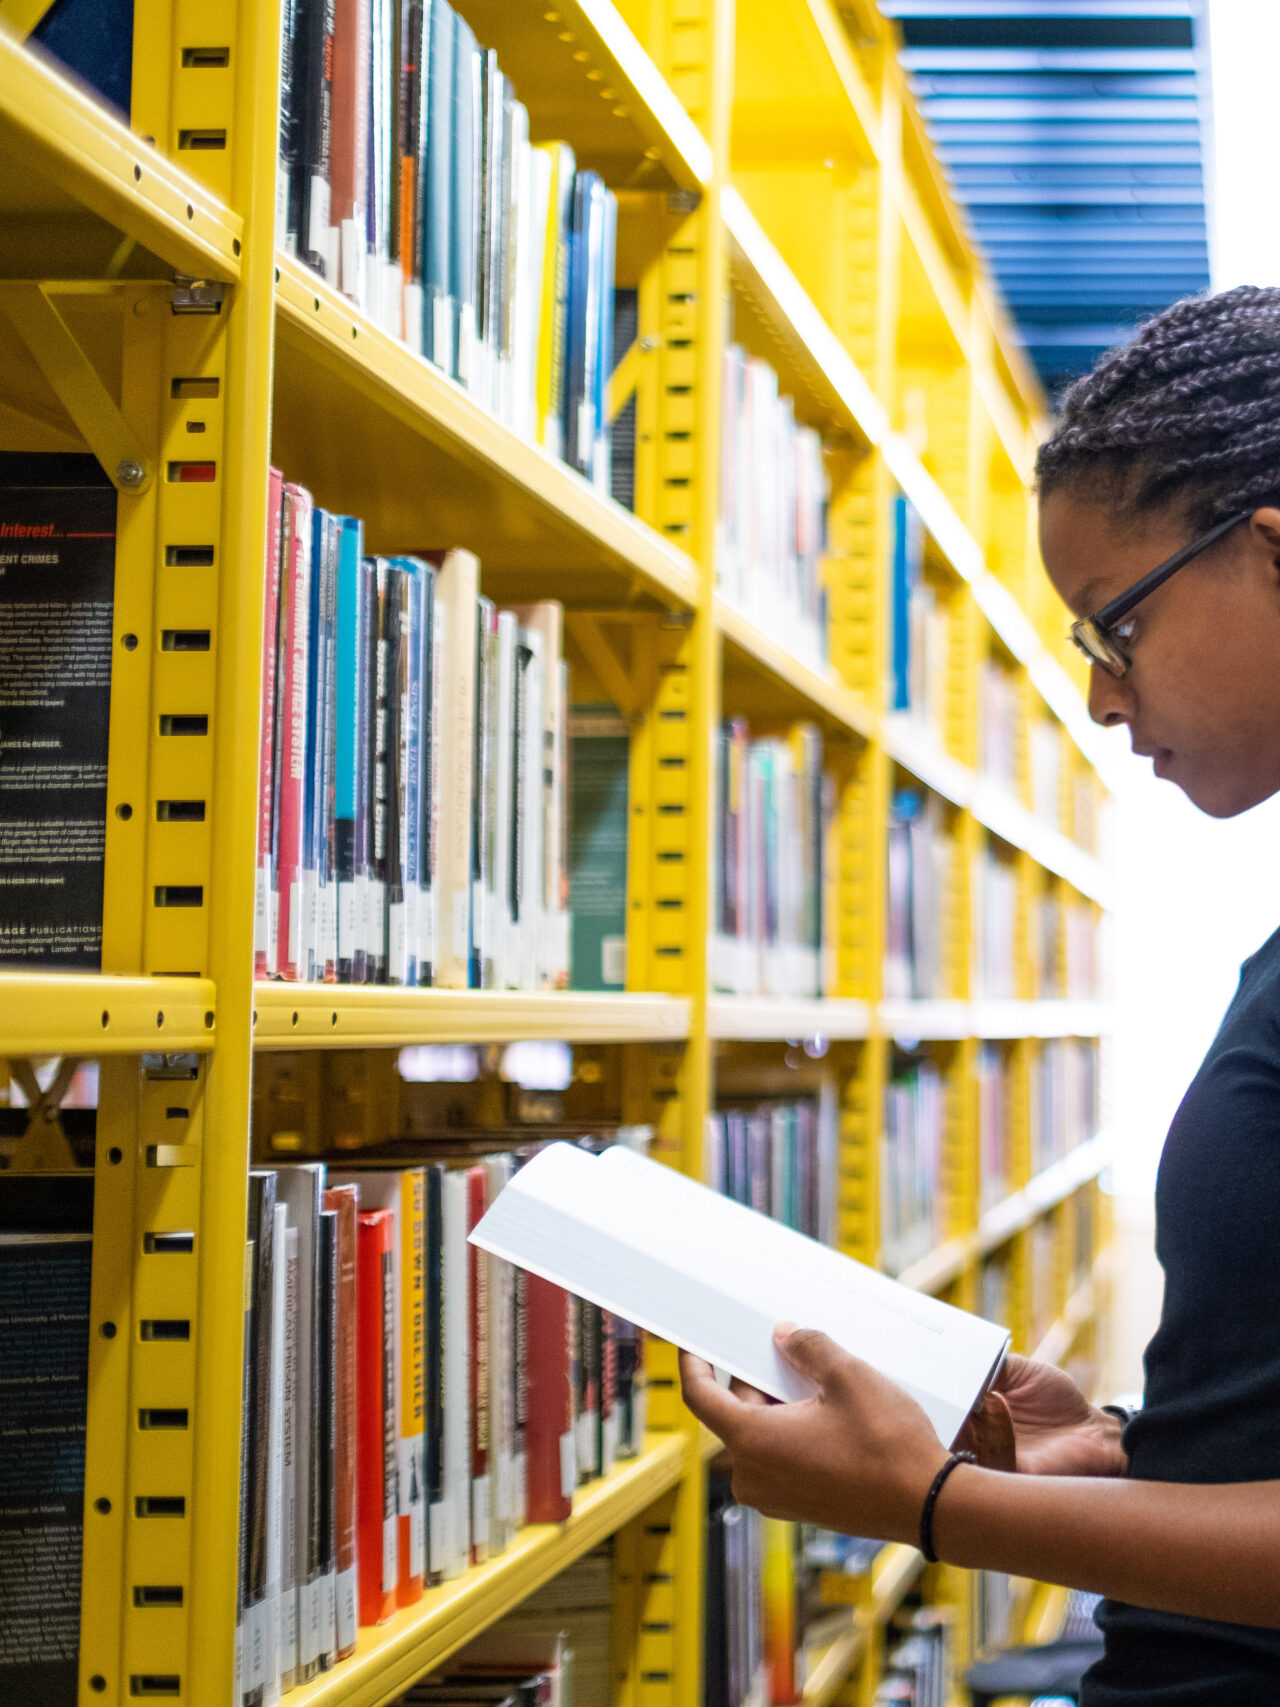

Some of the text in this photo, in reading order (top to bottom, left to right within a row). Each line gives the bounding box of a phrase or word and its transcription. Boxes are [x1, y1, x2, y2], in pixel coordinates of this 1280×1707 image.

[0, 522, 66, 539] Interest...
[21, 554, 60, 564] CRIMES
[293, 577, 305, 650] CRIMINAL
[292, 652, 303, 714] JUSTICE
[290, 715, 302, 780] SYSTEM
[69, 837, 99, 845] systematic
[375, 803, 385, 860] Crime
[29, 926, 103, 935] PUBLICATIONS
[284, 1258, 294, 1467] AMERICAN PRISON SYSTEM
[412, 1302, 422, 1420] TOGETHER
